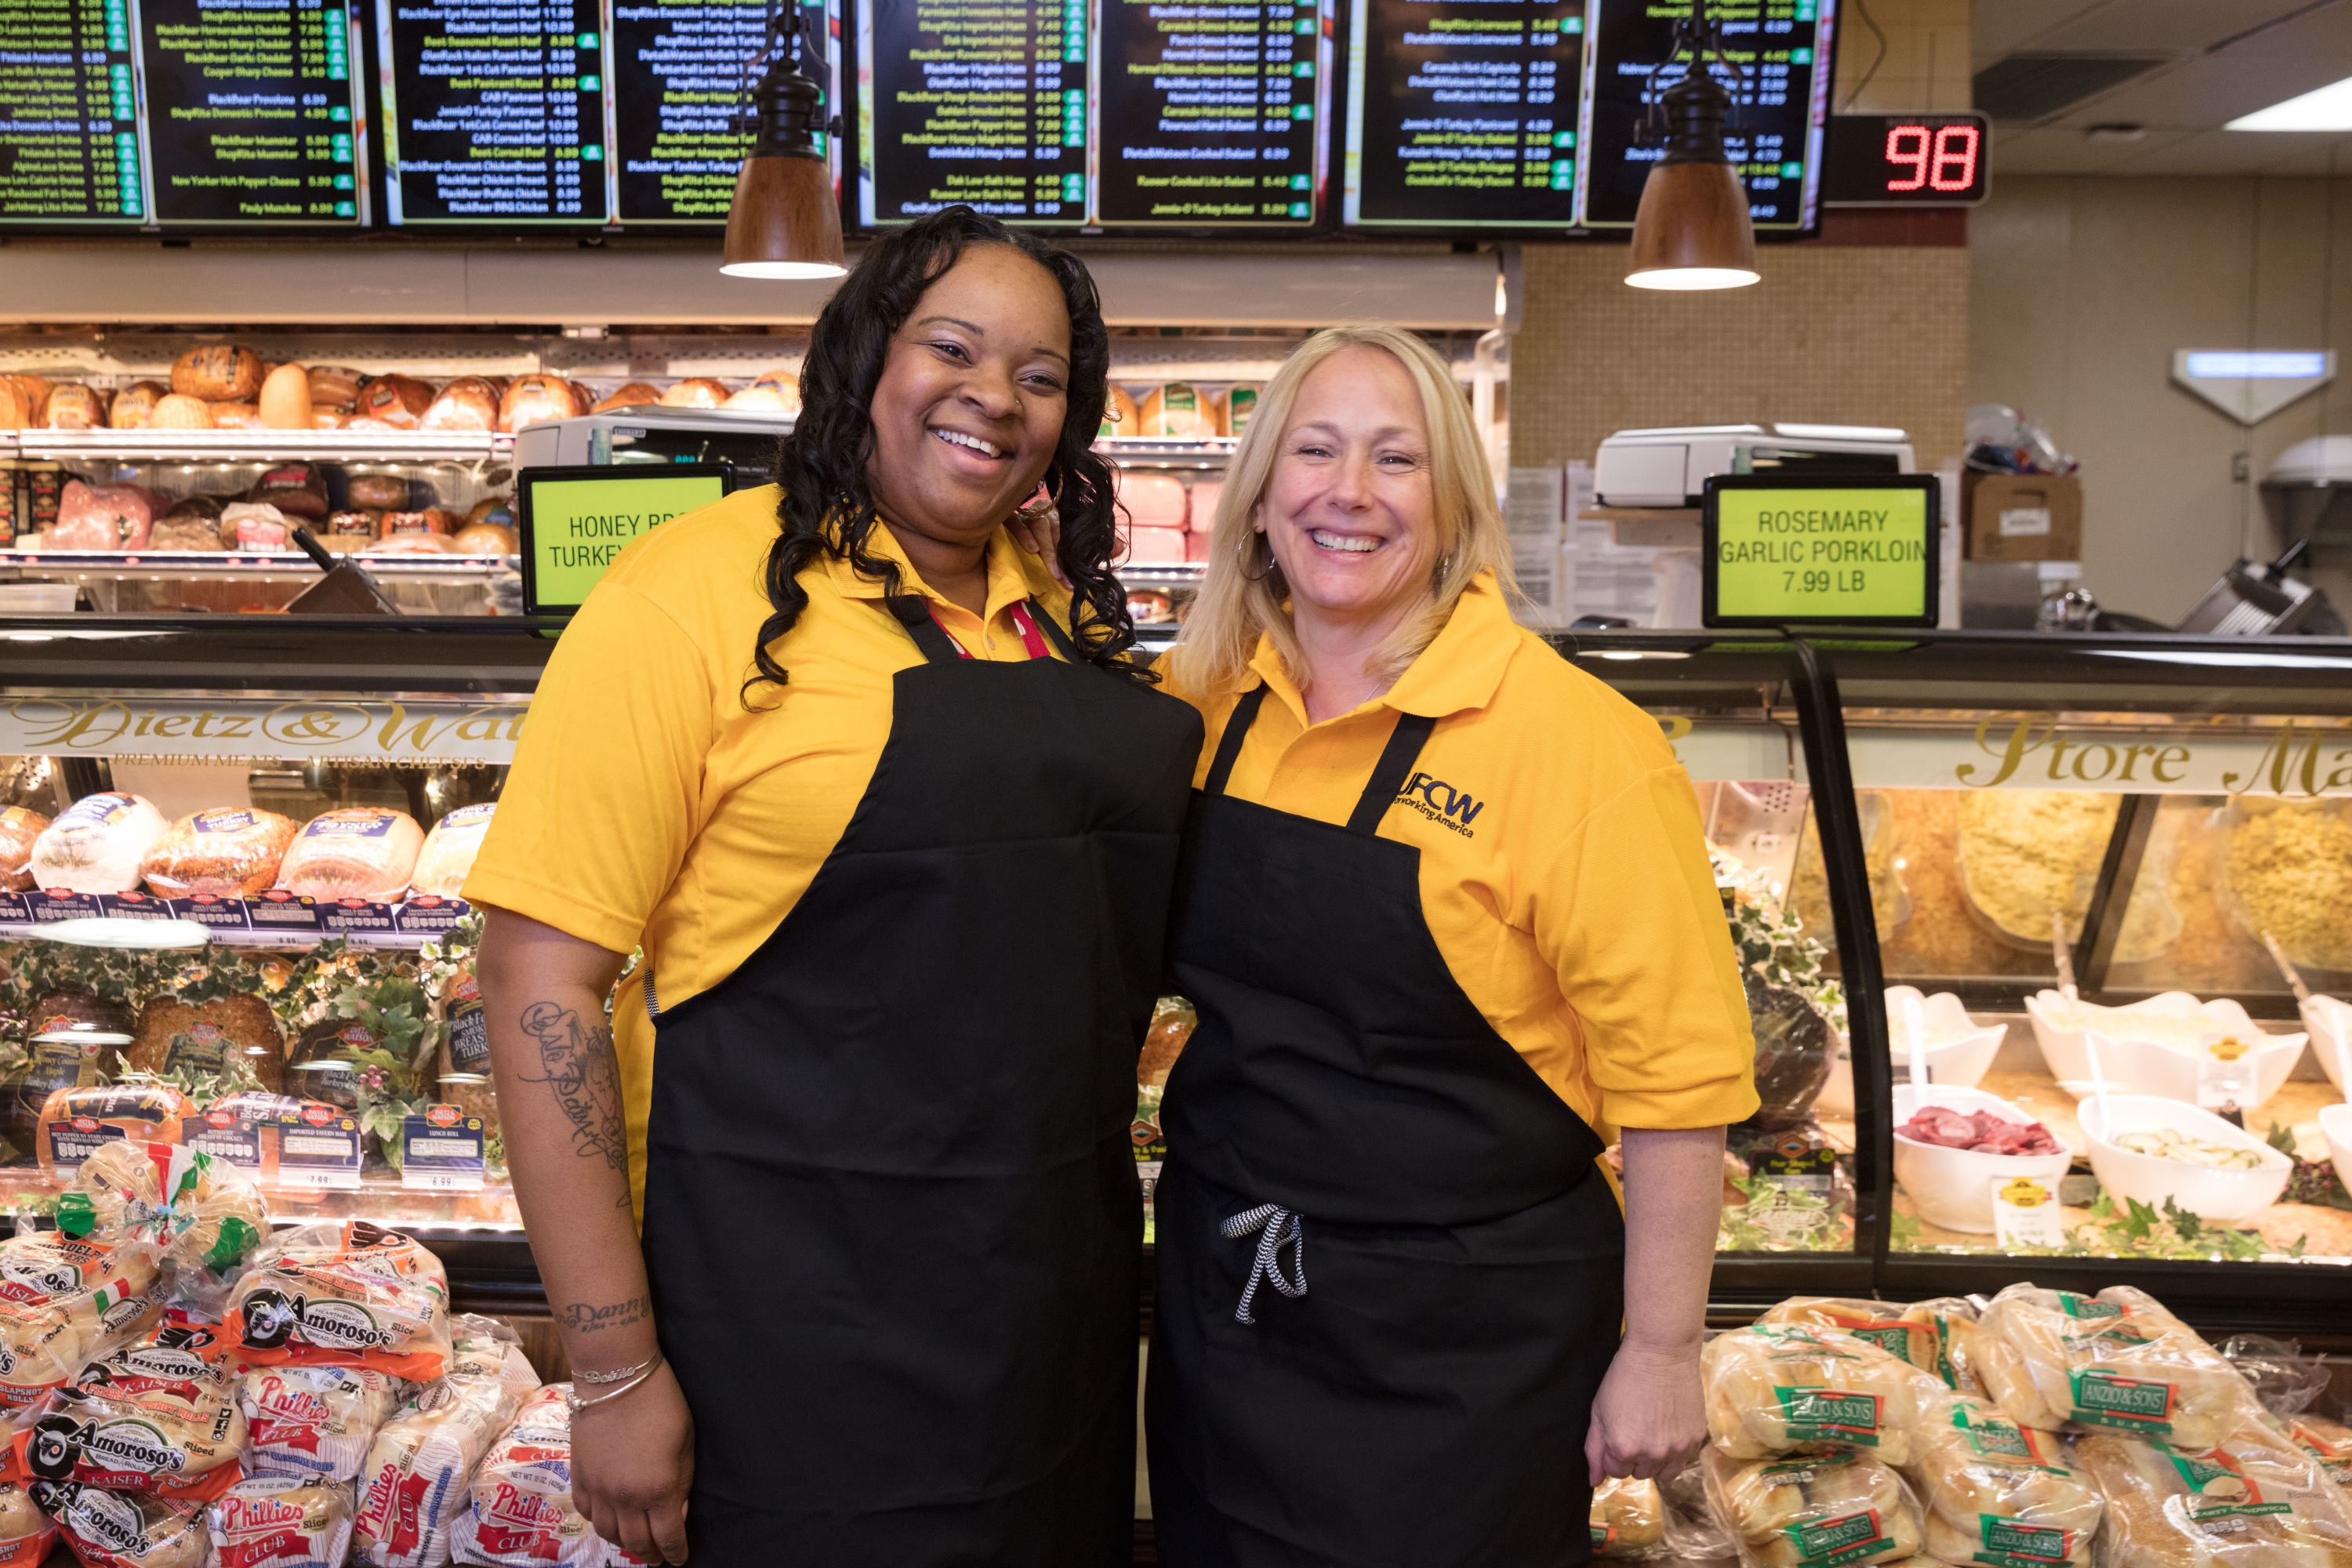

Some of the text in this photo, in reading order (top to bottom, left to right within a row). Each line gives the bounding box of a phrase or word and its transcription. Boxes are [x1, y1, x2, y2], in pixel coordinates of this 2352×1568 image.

[1886, 125, 1979, 191] 98
[570, 514, 641, 538] HONEY
[1759, 510, 1888, 533] ROSEMARY
[1720, 539, 1926, 563] GARLIC PORKLOIN
[1783, 570, 1865, 592] 7.99 LB
[9, 698, 257, 748] Dietz
[281, 711, 341, 739] &
[114, 753, 213, 767] PREMIUM
[304, 755, 391, 769] ARTISAN
[1956, 712, 2190, 788] Store
[1434, 813, 1474, 838] America
[343, 1033, 374, 1043] WATSON
[432, 1178, 452, 1187] 6.99
[291, 1294, 393, 1348] Amoroso's
[564, 1296, 651, 1325] Danny
[103, 1348, 225, 1385] Amoroso's
[0, 1385, 44, 1396] SLAPSHOT
[7, 1394, 34, 1403] ROLLS
[260, 1376, 332, 1421] Phillies
[2085, 1385, 2120, 1403] ANZIO
[2132, 1390, 2162, 1408] SONS
[1843, 1401, 1871, 1420] SONS
[107, 1431, 155, 1446] HEARTH-BAKED
[320, 1421, 347, 1436] Sliced
[68, 1419, 185, 1472] Amoroso's
[183, 1440, 215, 1457] Sliced
[96, 1454, 147, 1472] BREAD ROLLS
[511, 1470, 523, 1479] NET
[92, 1475, 144, 1486] KAISER
[220, 1497, 304, 1529] Phillies
[354, 1463, 398, 1540] Phillies
[491, 1481, 564, 1526] Phillies
[245, 1536, 286, 1563] CLUB
[416, 1529, 434, 1568] moroso's
[498, 1536, 540, 1550] CLUB
[1828, 1548, 1867, 1565] CLUB
